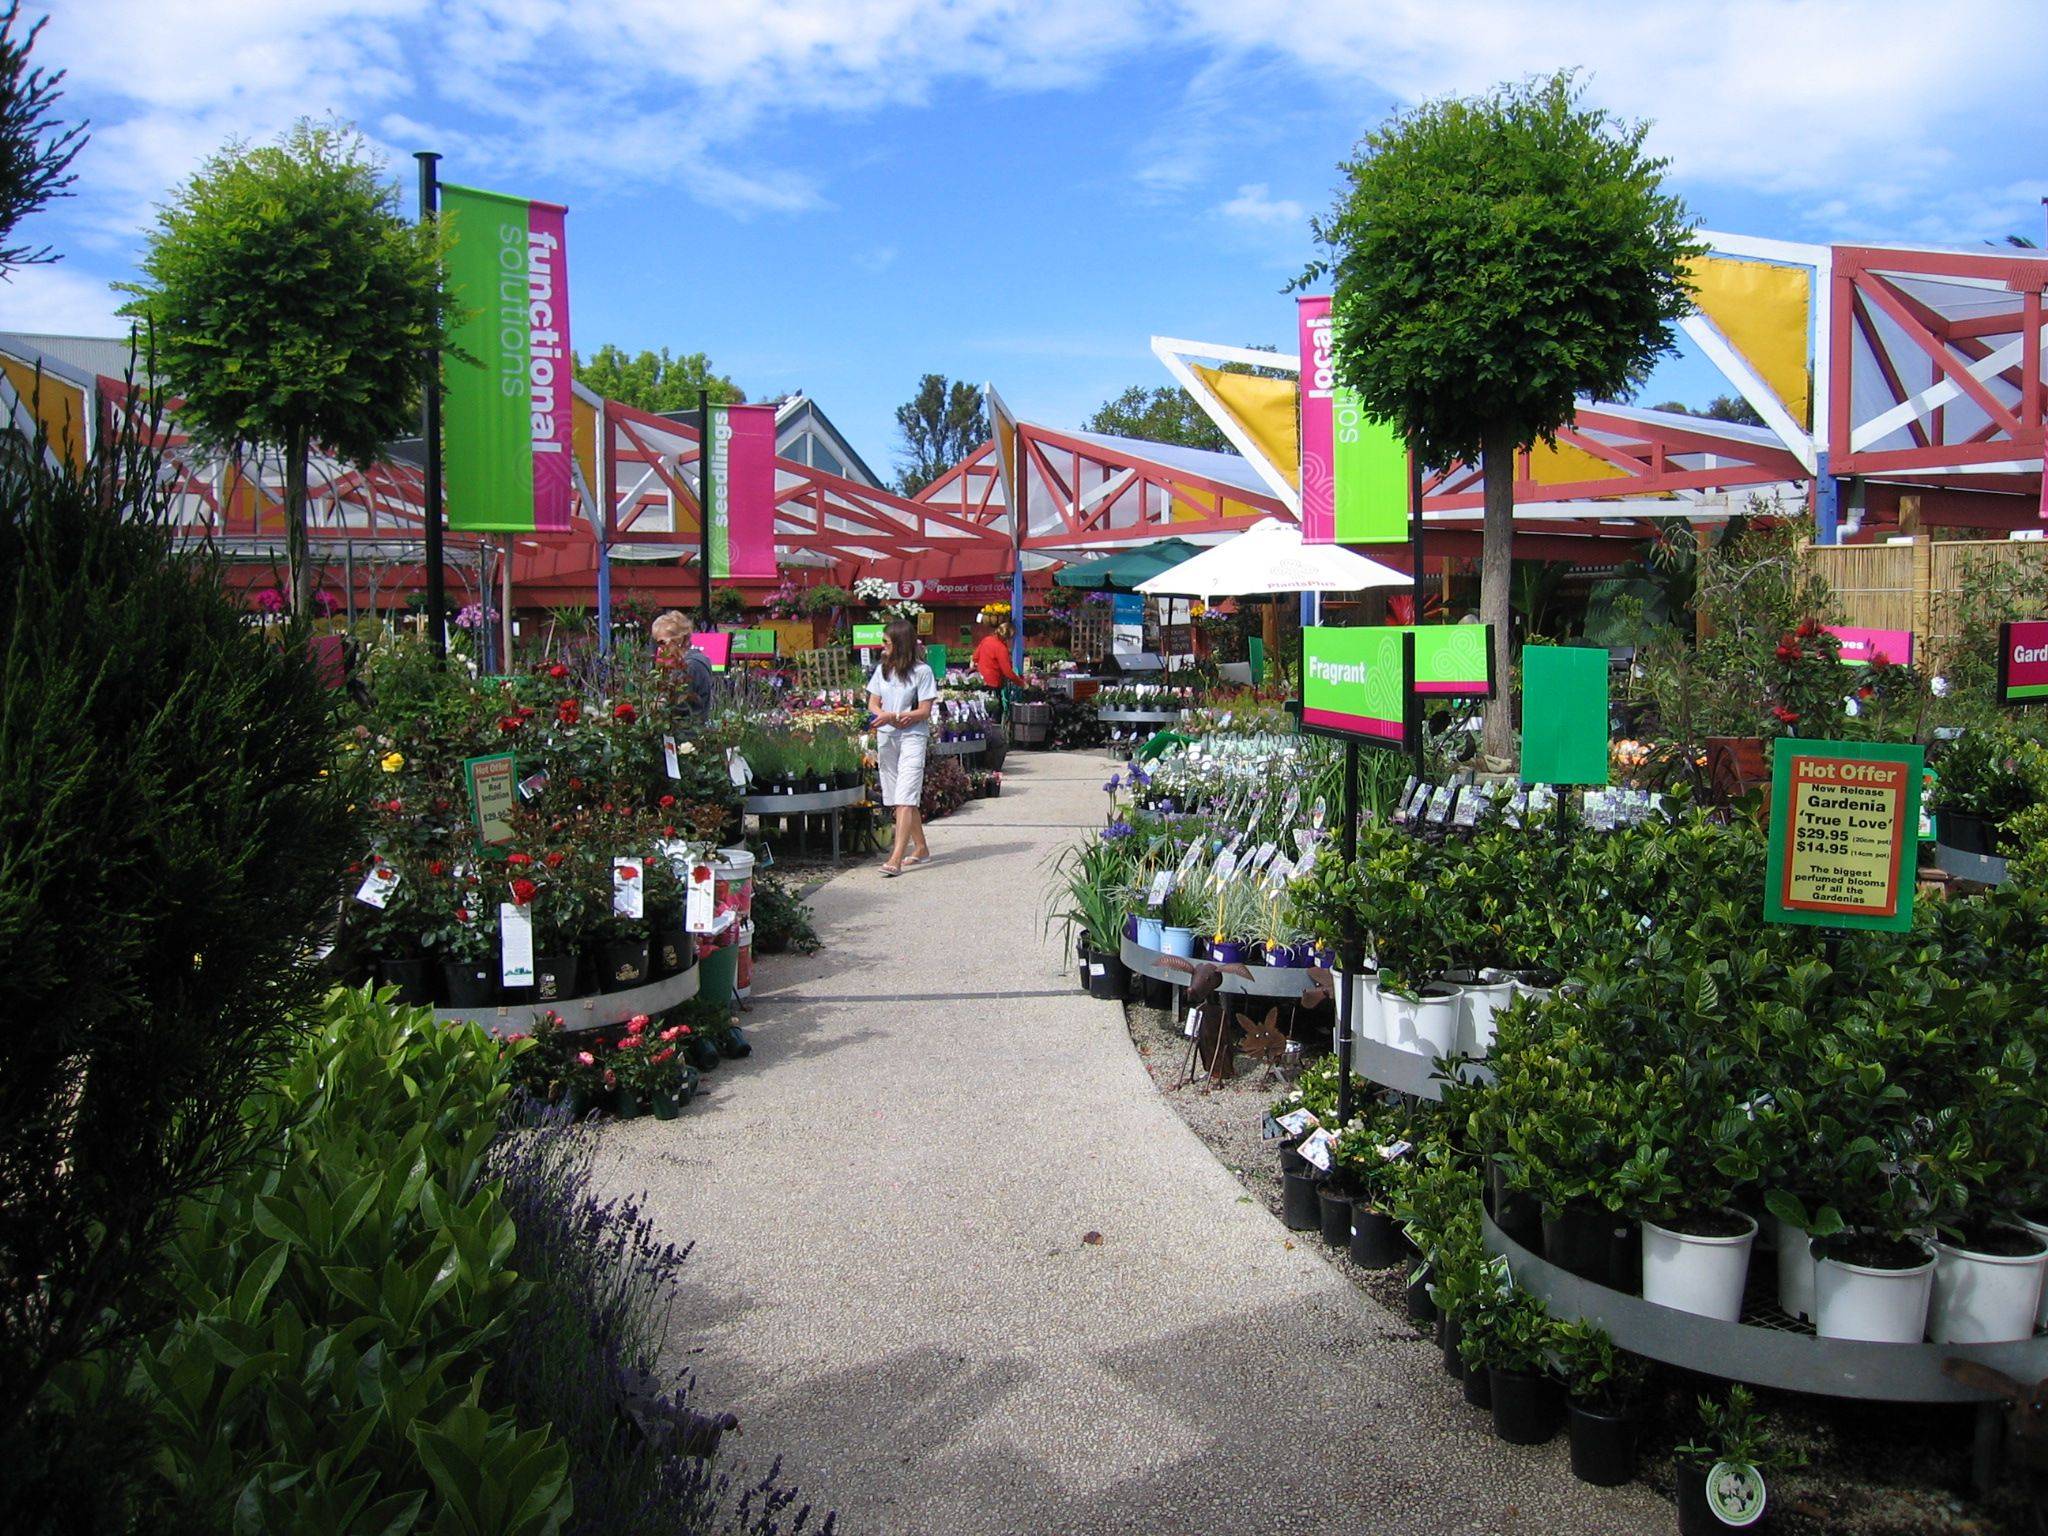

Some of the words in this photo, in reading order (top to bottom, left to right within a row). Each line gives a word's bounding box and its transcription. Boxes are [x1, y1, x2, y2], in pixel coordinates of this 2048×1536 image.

[500, 224, 529, 397] solutions
[528, 231, 563, 453] functional
[1307, 318, 1334, 398] local
[711, 411, 732, 528] seedlings
[937, 584, 954, 593] pop
[955, 584, 968, 592] out
[1309, 655, 1366, 686] Fragrant
[476, 766, 489, 774] Hot
[490, 763, 509, 772] Offer
[1798, 761, 1836, 779] Hot
[1840, 763, 1898, 783] Offer
[1811, 783, 1836, 793] New
[1840, 786, 1884, 797] Release
[1807, 795, 1886, 812] Gardenia
[1797, 827, 1849, 841] $29.95
[1852, 836, 1875, 844] (20cm
[1796, 841, 1848, 855] $14.95
[1850, 850, 1873, 858] (14cm
[1810, 865, 1829, 874] The
[1833, 867, 1872, 878] biggest
[1794, 874, 1844, 884] perfumed
[1848, 877, 1886, 888] blooms
[1812, 892, 1865, 904] Gardenias
[1829, 885, 1842, 893] all
[1846, 887, 1864, 895] the
